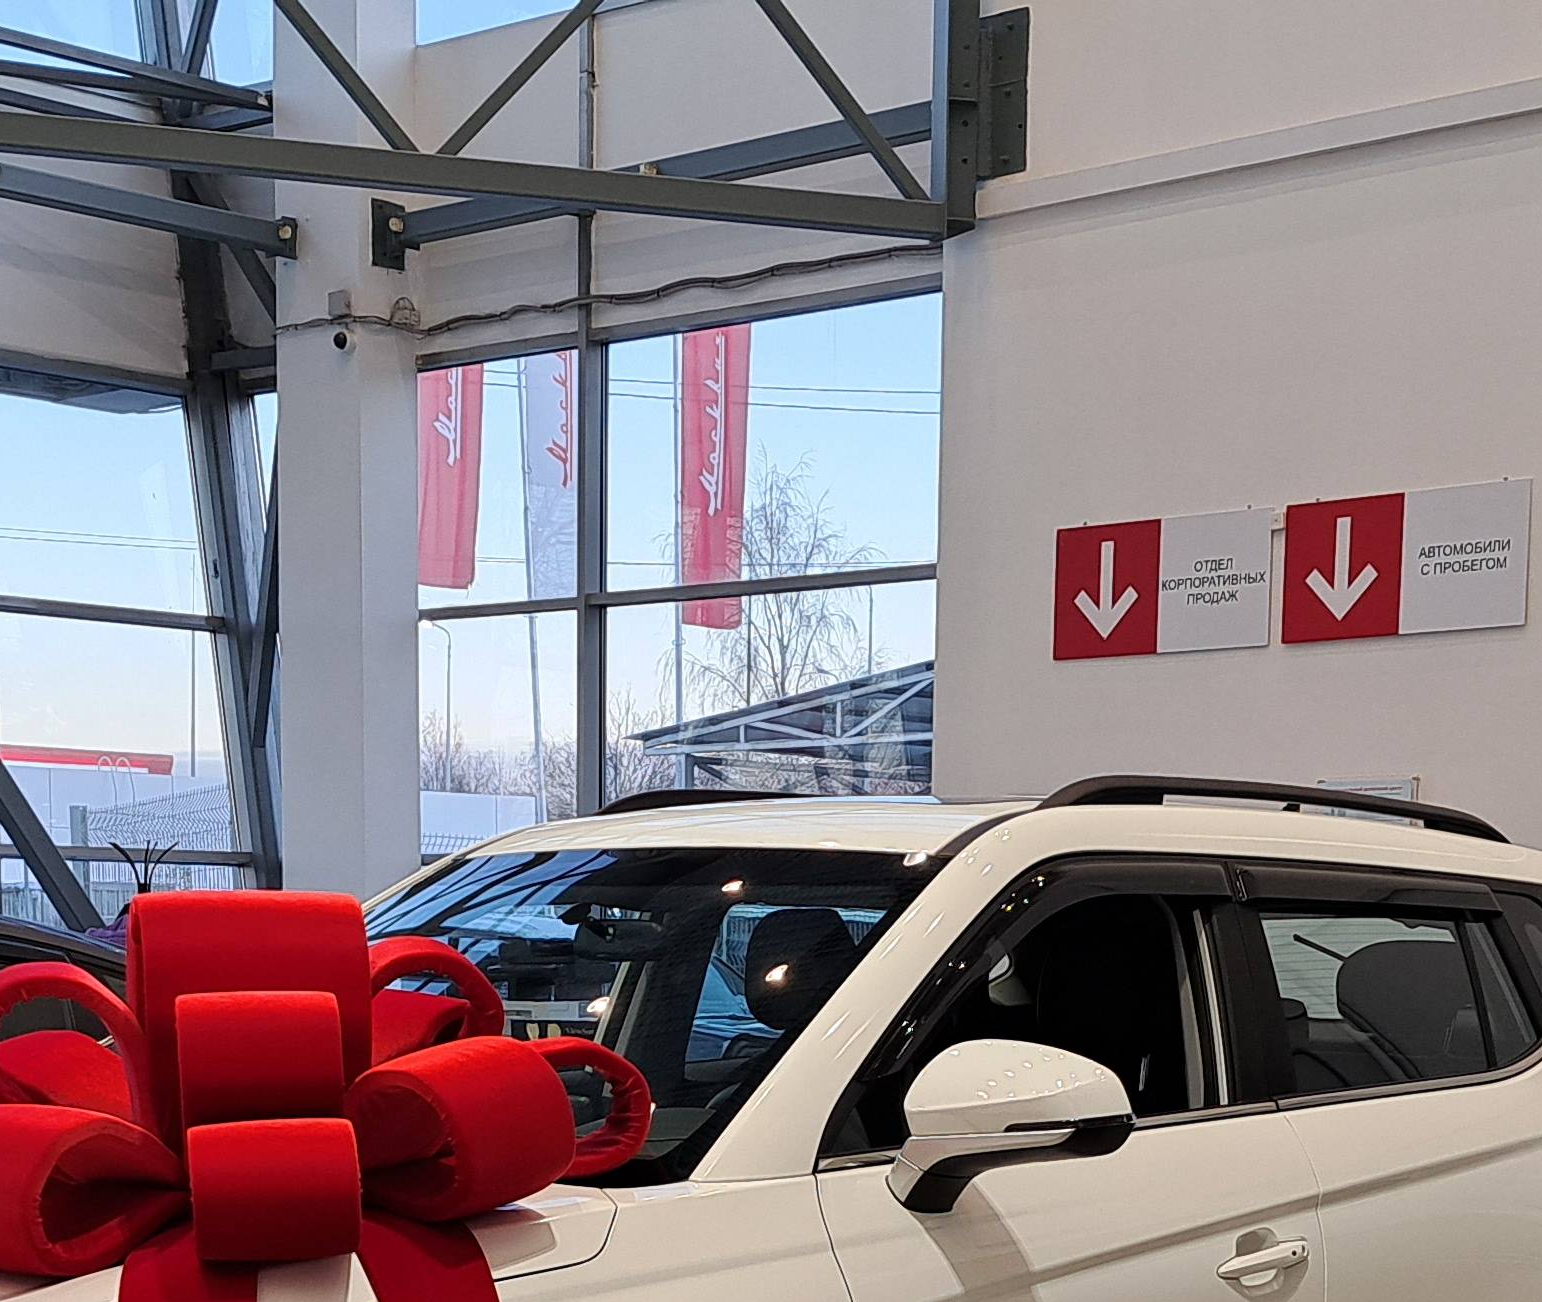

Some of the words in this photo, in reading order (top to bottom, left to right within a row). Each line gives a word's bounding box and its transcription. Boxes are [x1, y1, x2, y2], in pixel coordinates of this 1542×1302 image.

[1418, 538, 1511, 559] АВТОМОБИЛИ
[1193, 557, 1233, 573] ОТДЕЛ
[1420, 563, 1430, 575] С
[1433, 556, 1507, 575] ПРОБЕГОМ
[1161, 570, 1266, 591] КОРПОРАТИВНЫХ
[1187, 590, 1239, 605] ПРОДАЖ
